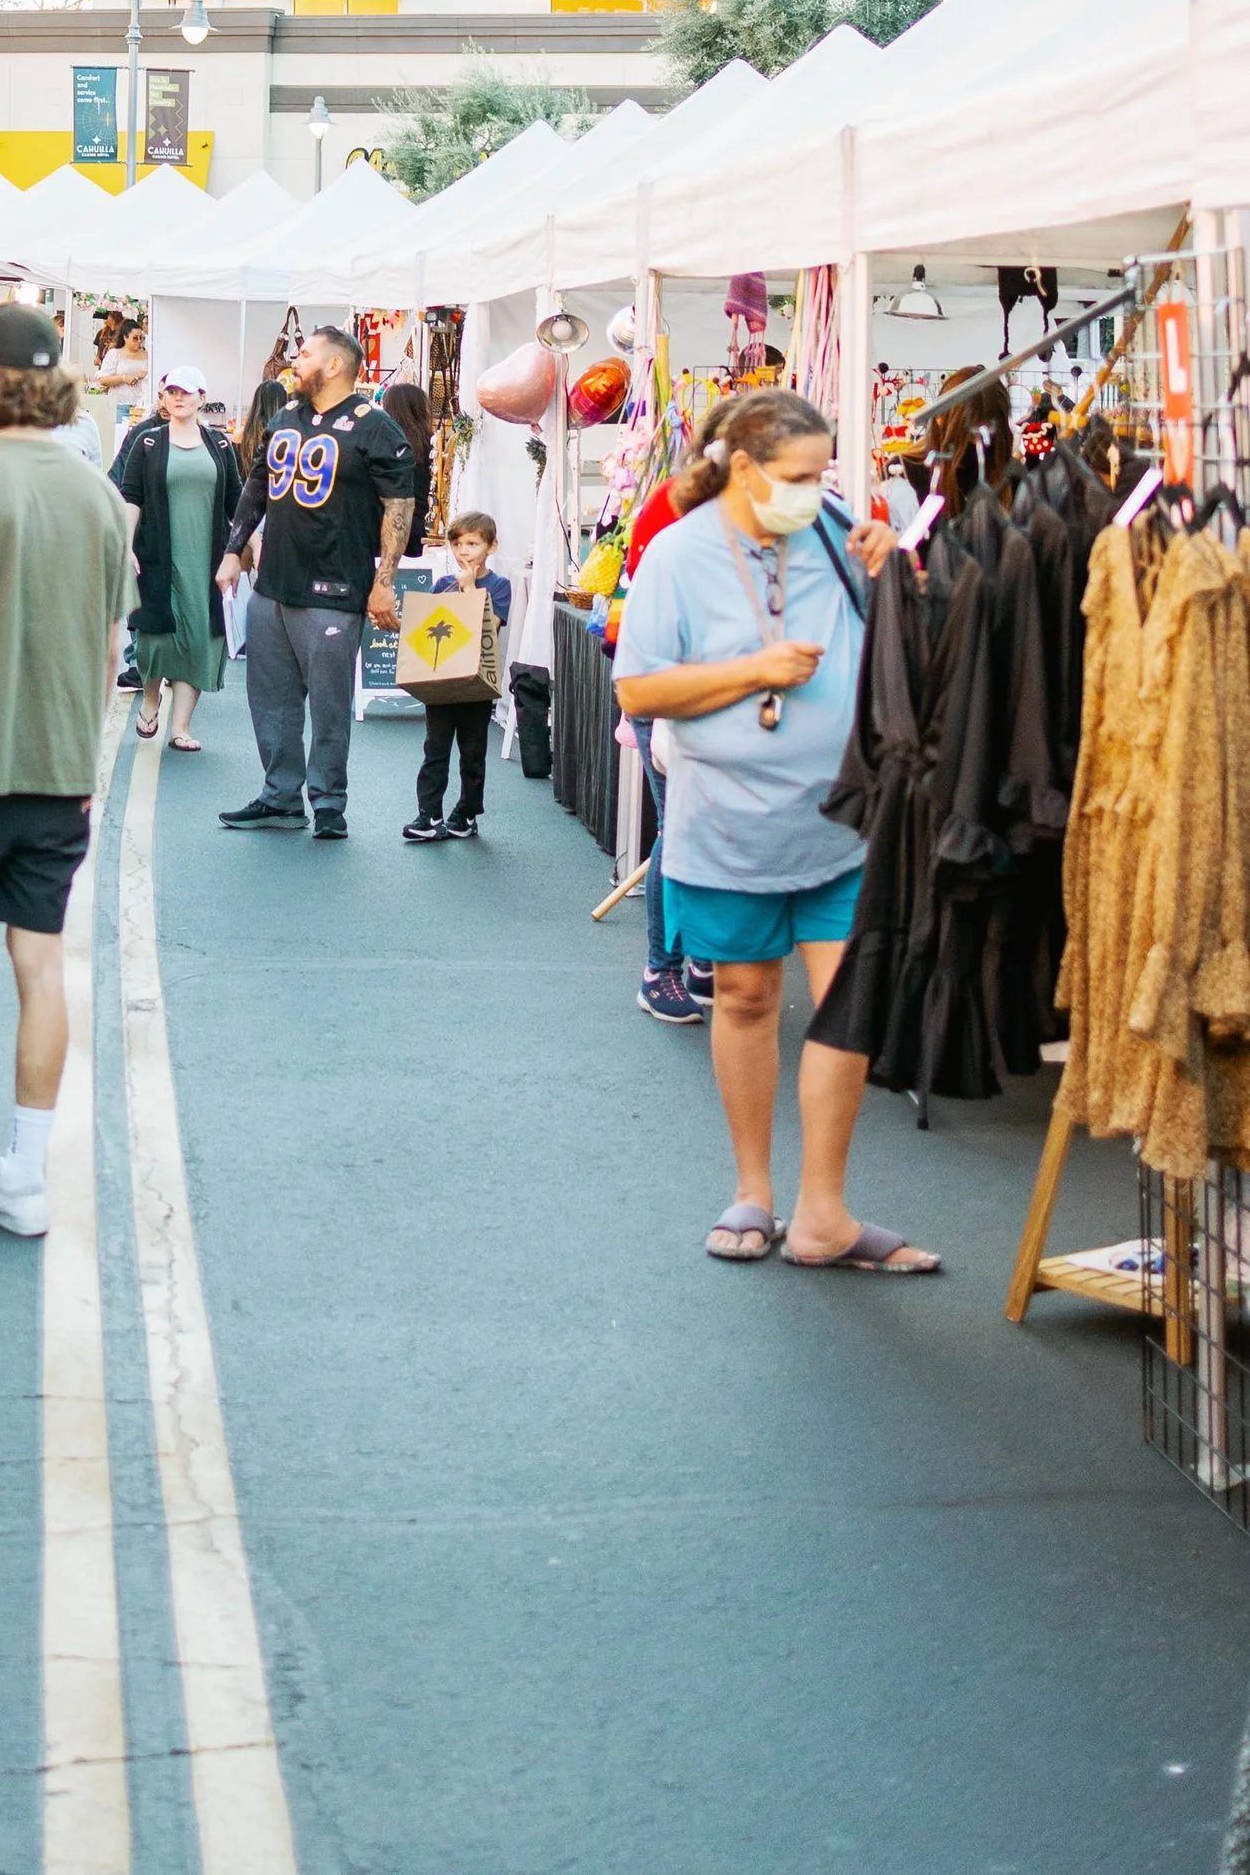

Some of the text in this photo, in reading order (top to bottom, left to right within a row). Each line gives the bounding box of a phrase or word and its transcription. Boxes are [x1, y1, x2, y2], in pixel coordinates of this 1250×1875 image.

[77, 145, 114, 153] CAHUILLA
[148, 146, 184, 155] CAHUILLA
[267, 428, 339, 509] 99
[370, 638, 388, 648] look
[481, 593, 498, 691] alifor
